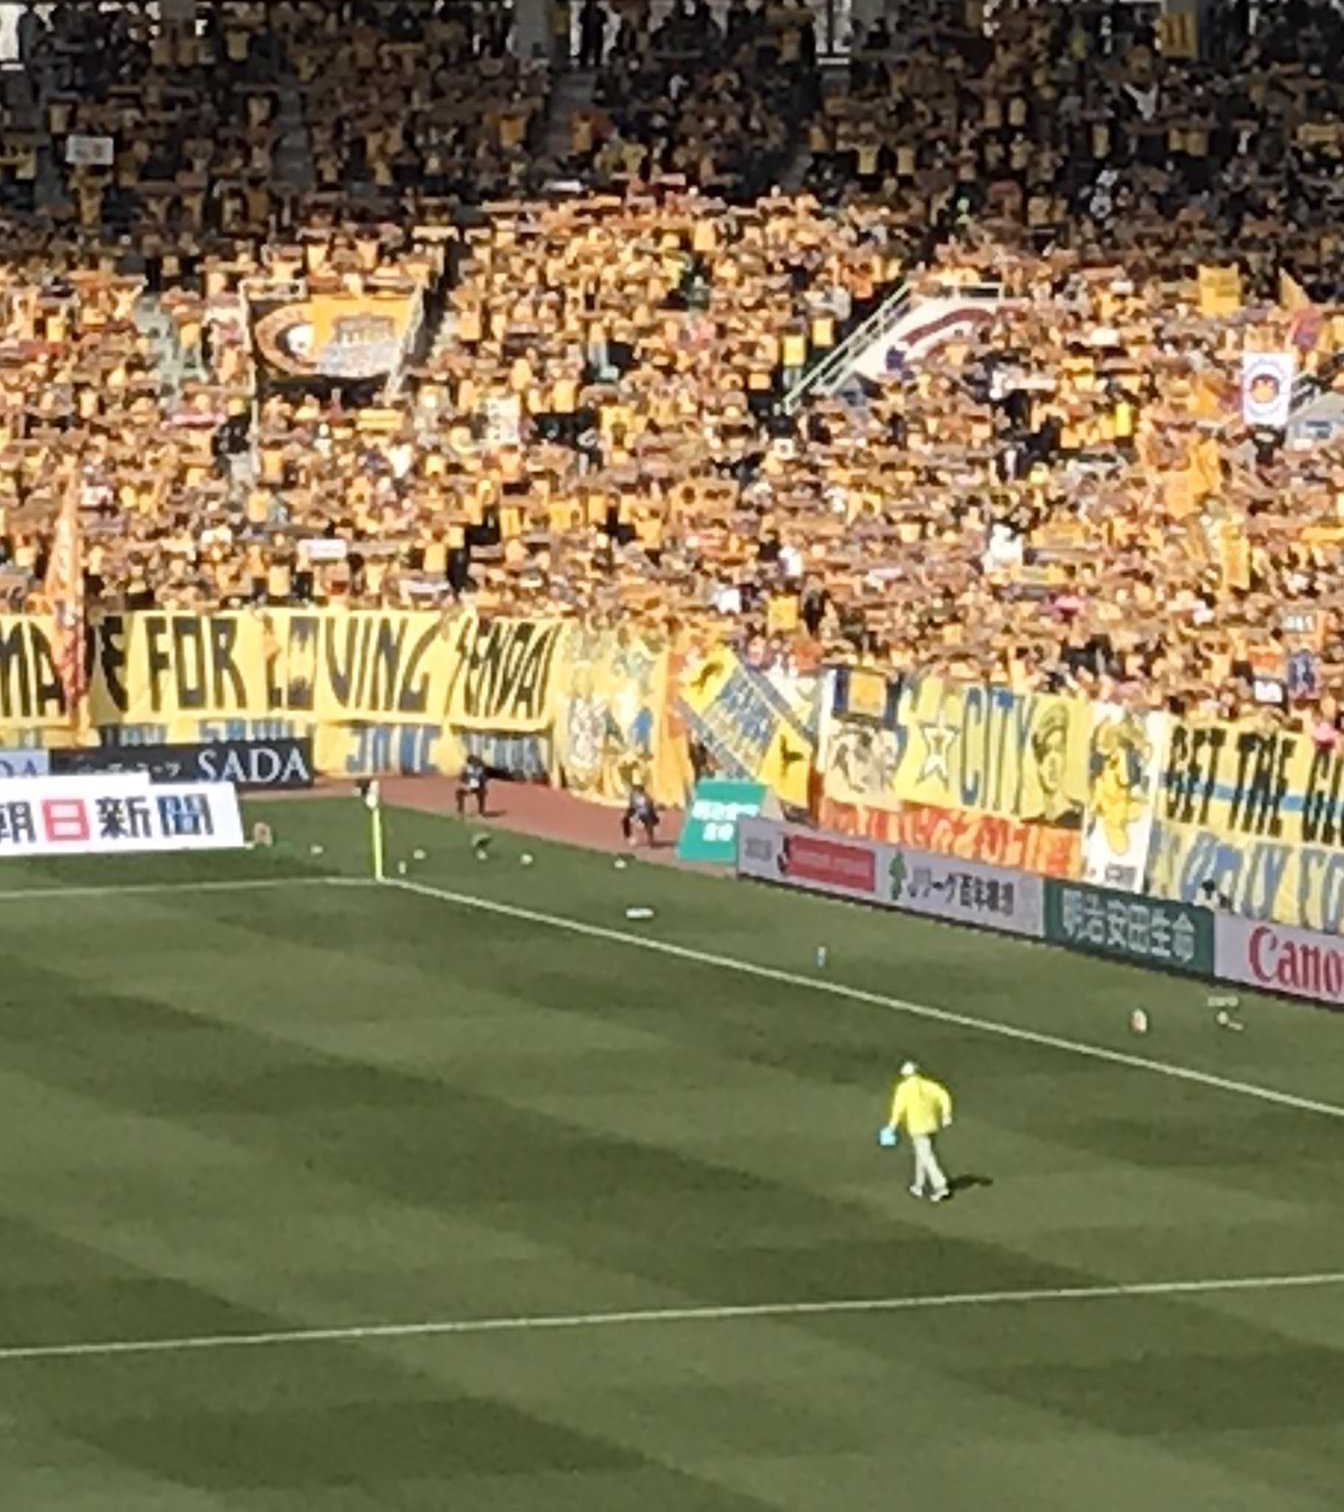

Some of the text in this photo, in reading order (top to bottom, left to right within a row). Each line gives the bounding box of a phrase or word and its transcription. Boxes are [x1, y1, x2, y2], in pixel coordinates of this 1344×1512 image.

[145, 616, 248, 712] FOR
[197, 747, 311, 785] SADA
[959, 680, 1039, 816] CITY
